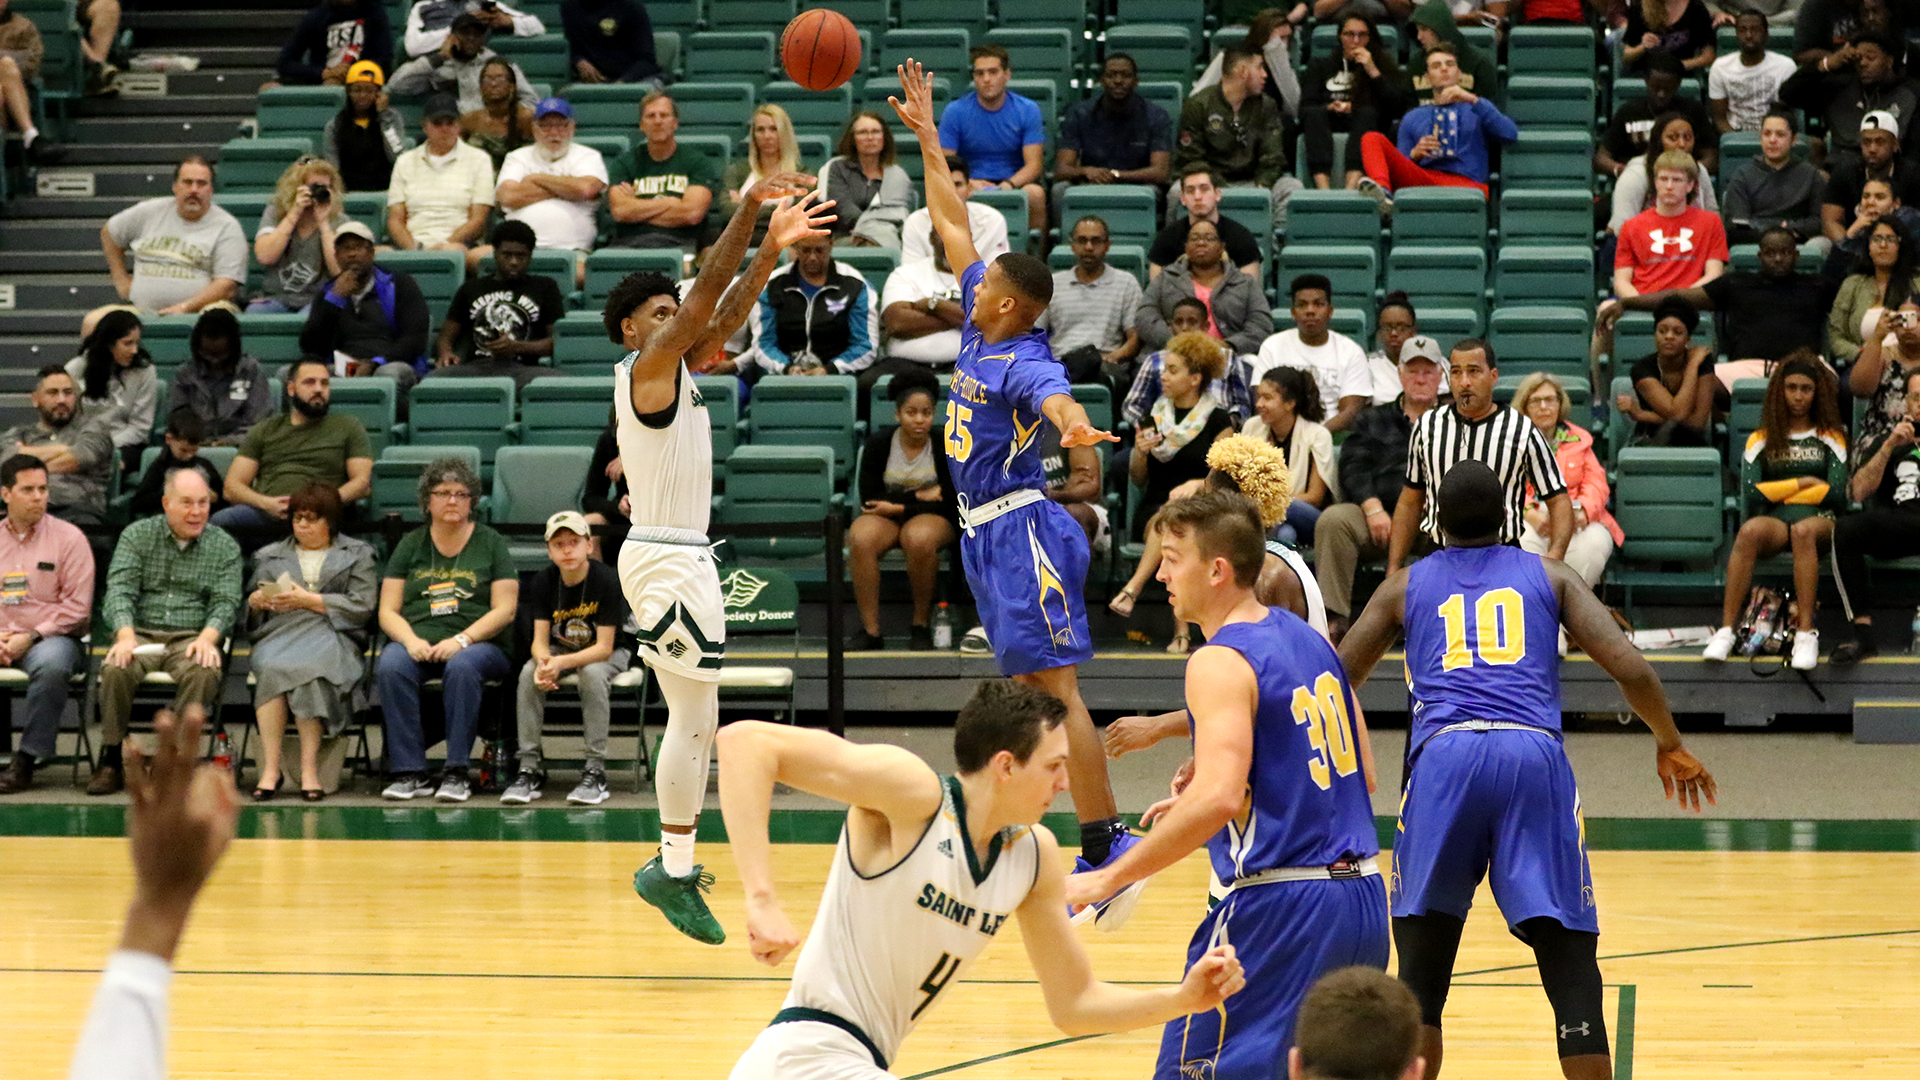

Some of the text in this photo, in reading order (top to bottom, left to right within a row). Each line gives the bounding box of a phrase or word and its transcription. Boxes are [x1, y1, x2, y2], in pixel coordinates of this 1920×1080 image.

[944, 399, 974, 463] 25
[723, 610, 795, 623] ociety Donor
[1438, 586, 1526, 673] 10
[1290, 670, 1358, 791] 30
[917, 881, 1010, 937] SAINT LE
[911, 951, 963, 1022] 4
